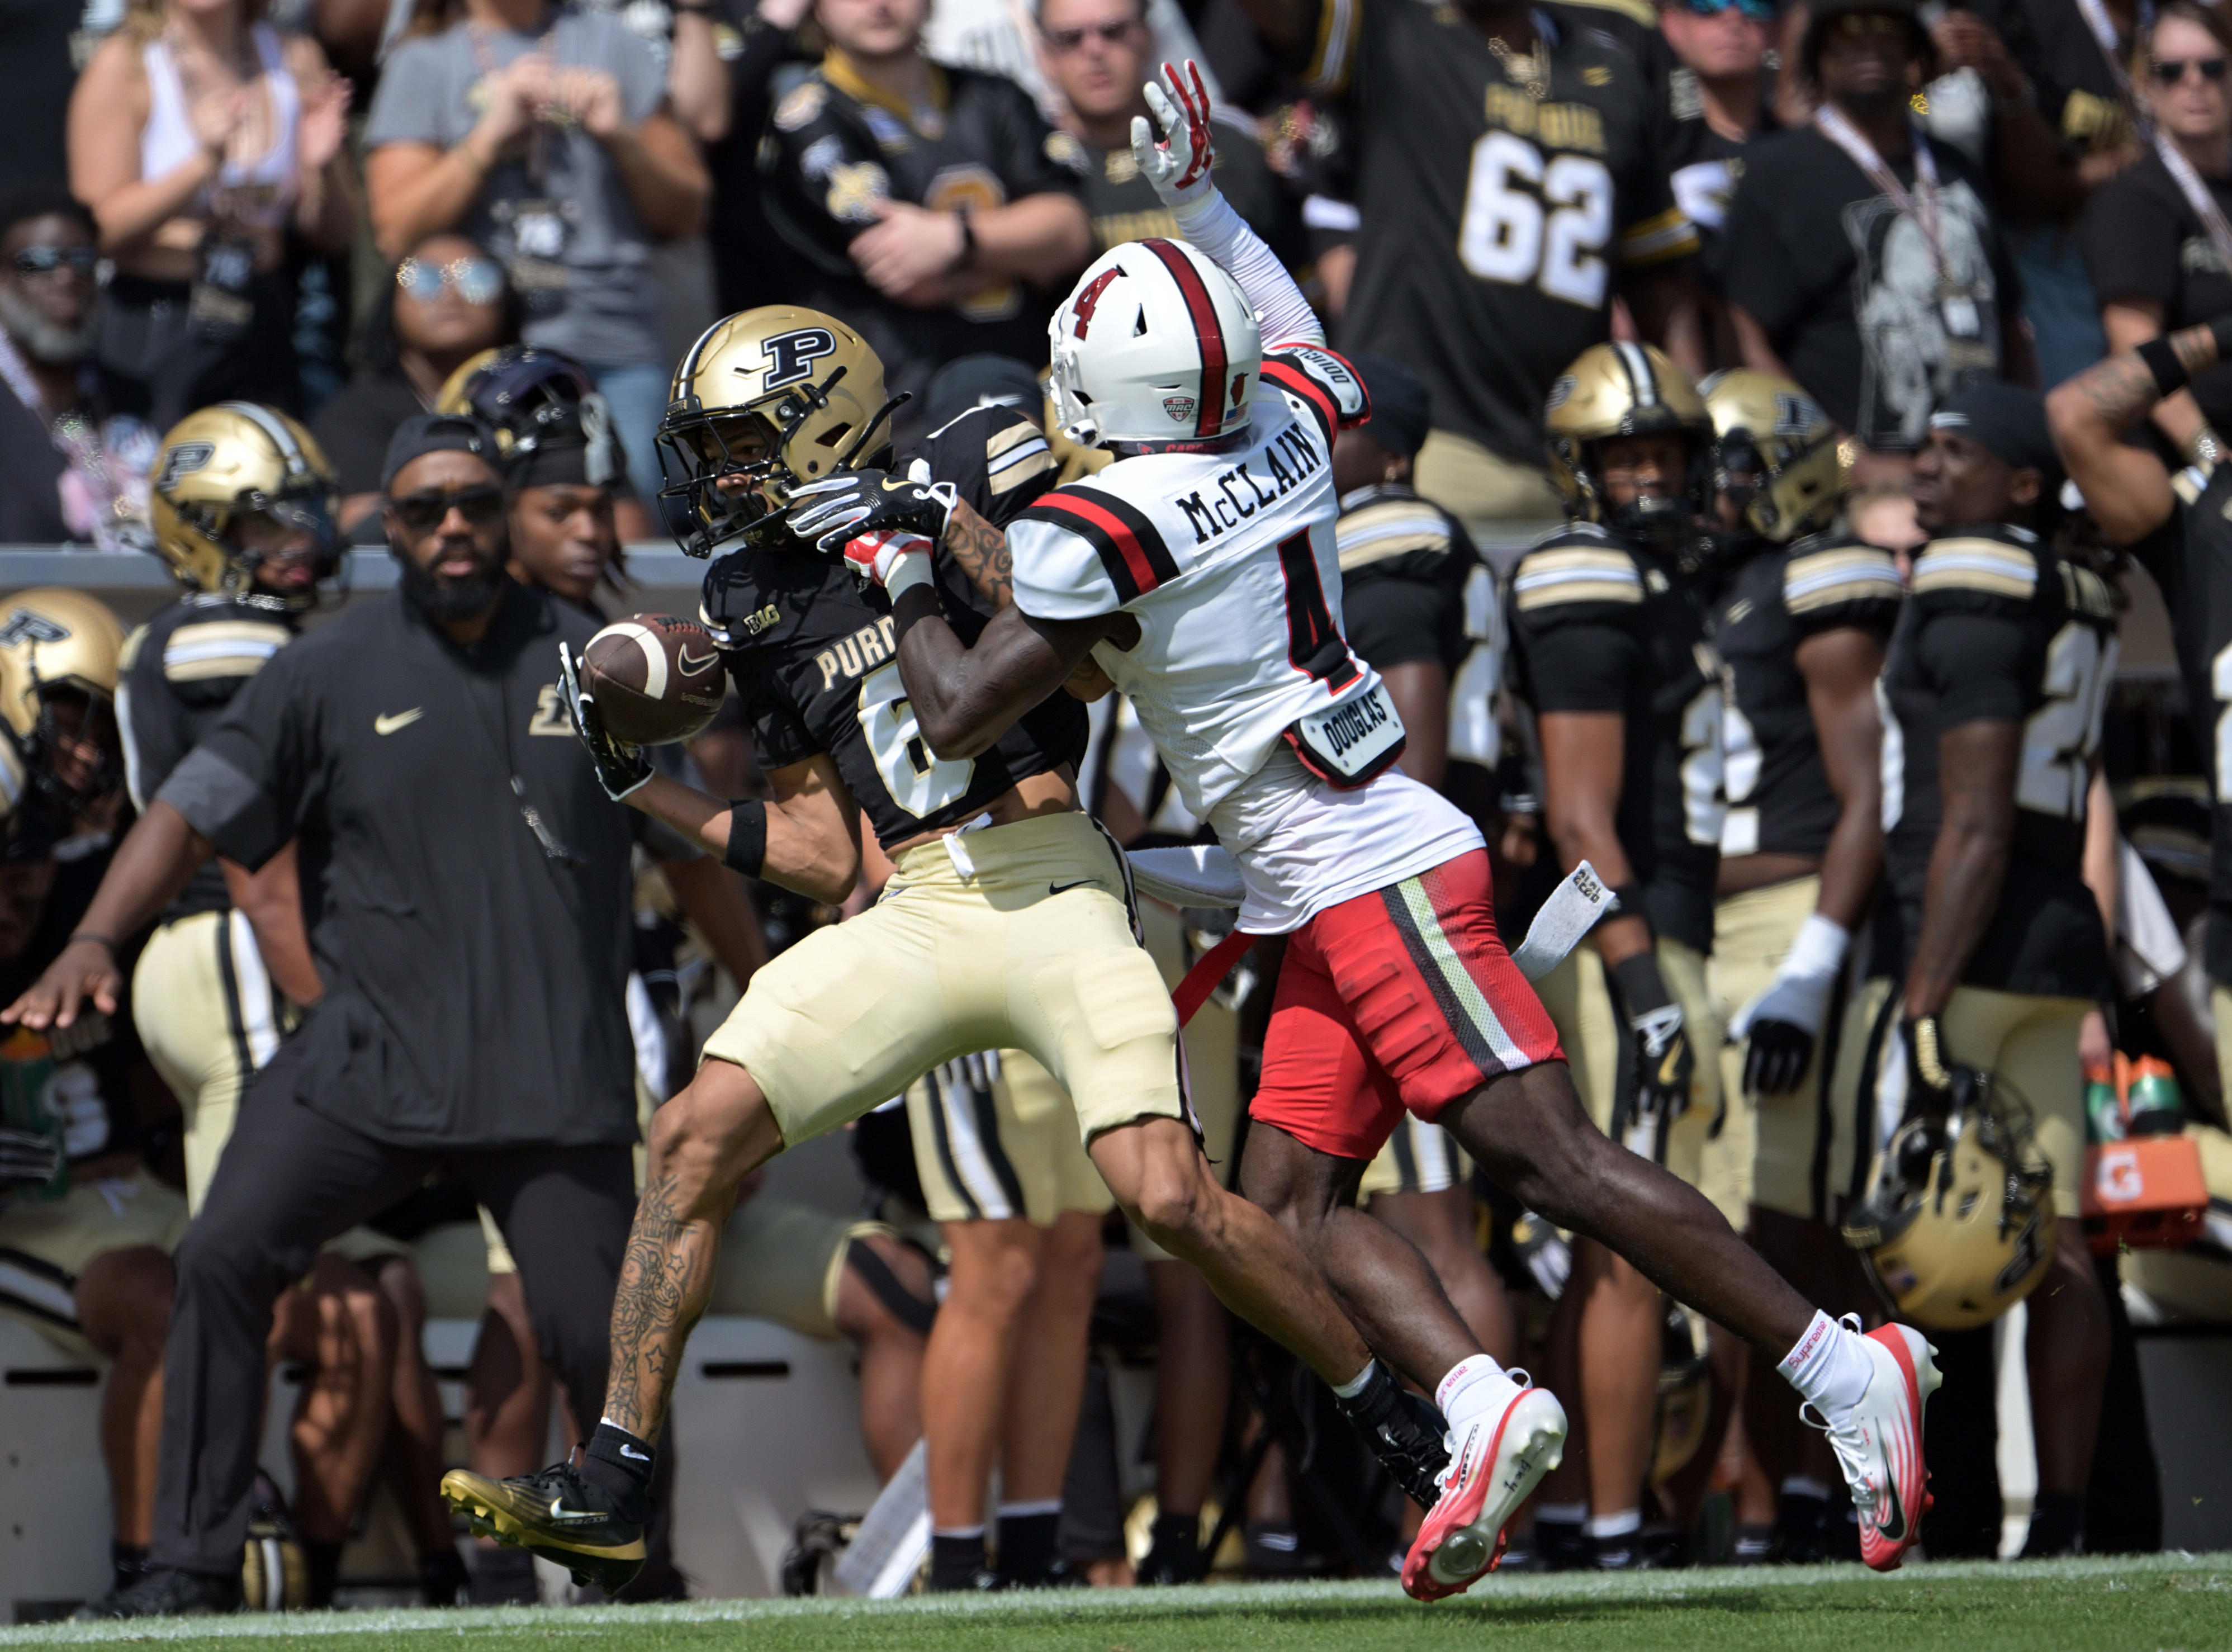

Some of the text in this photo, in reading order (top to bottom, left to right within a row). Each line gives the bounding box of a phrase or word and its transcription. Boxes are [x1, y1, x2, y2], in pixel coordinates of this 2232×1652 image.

[1458, 129, 1614, 311] 62
[1073, 268, 1120, 342] 4
[761, 327, 836, 394] P
[1165, 404, 1193, 412] MAC
[1176, 422, 1321, 545] McCLAIN
[1277, 524, 1364, 697] 4
[1322, 689, 1387, 758] DOUGLAS
[1788, 1320, 1827, 1370] Supreme
[584, 1515, 608, 1524] ZOOM
